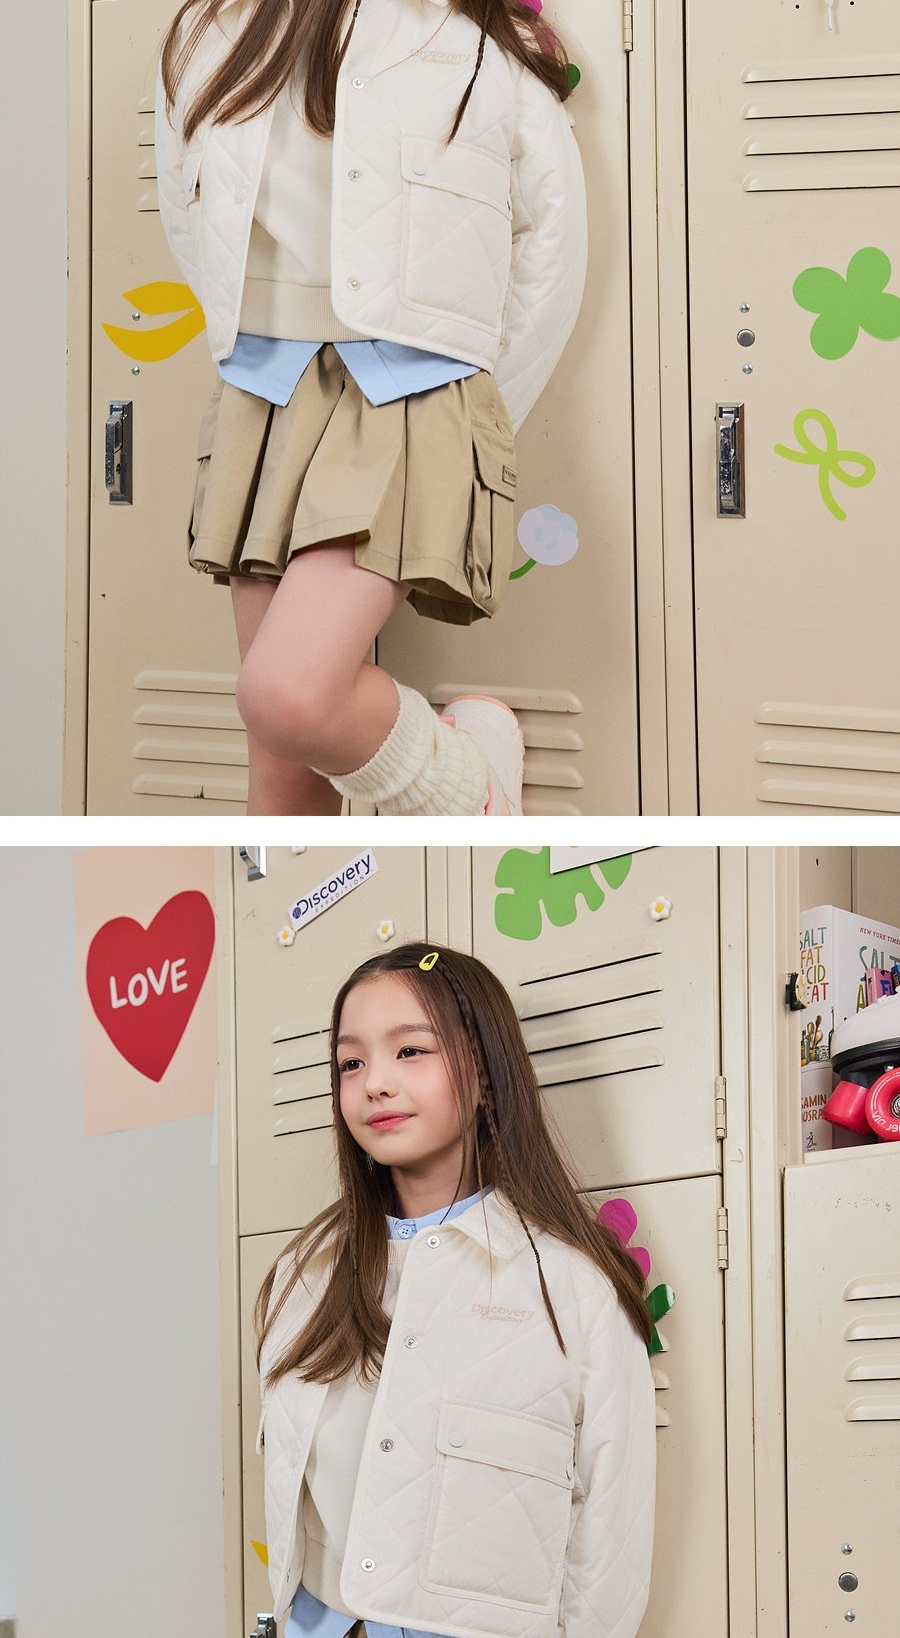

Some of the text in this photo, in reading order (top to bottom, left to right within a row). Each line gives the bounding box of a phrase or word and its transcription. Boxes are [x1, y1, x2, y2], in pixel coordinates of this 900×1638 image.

[292, 854, 371, 919] Discovery
[859, 927, 872, 935] NEW
[872, 931, 887, 941] YORK
[800, 945, 823, 969] FAT
[110, 957, 189, 1010] LOVE
[801, 964, 826, 985] CID
